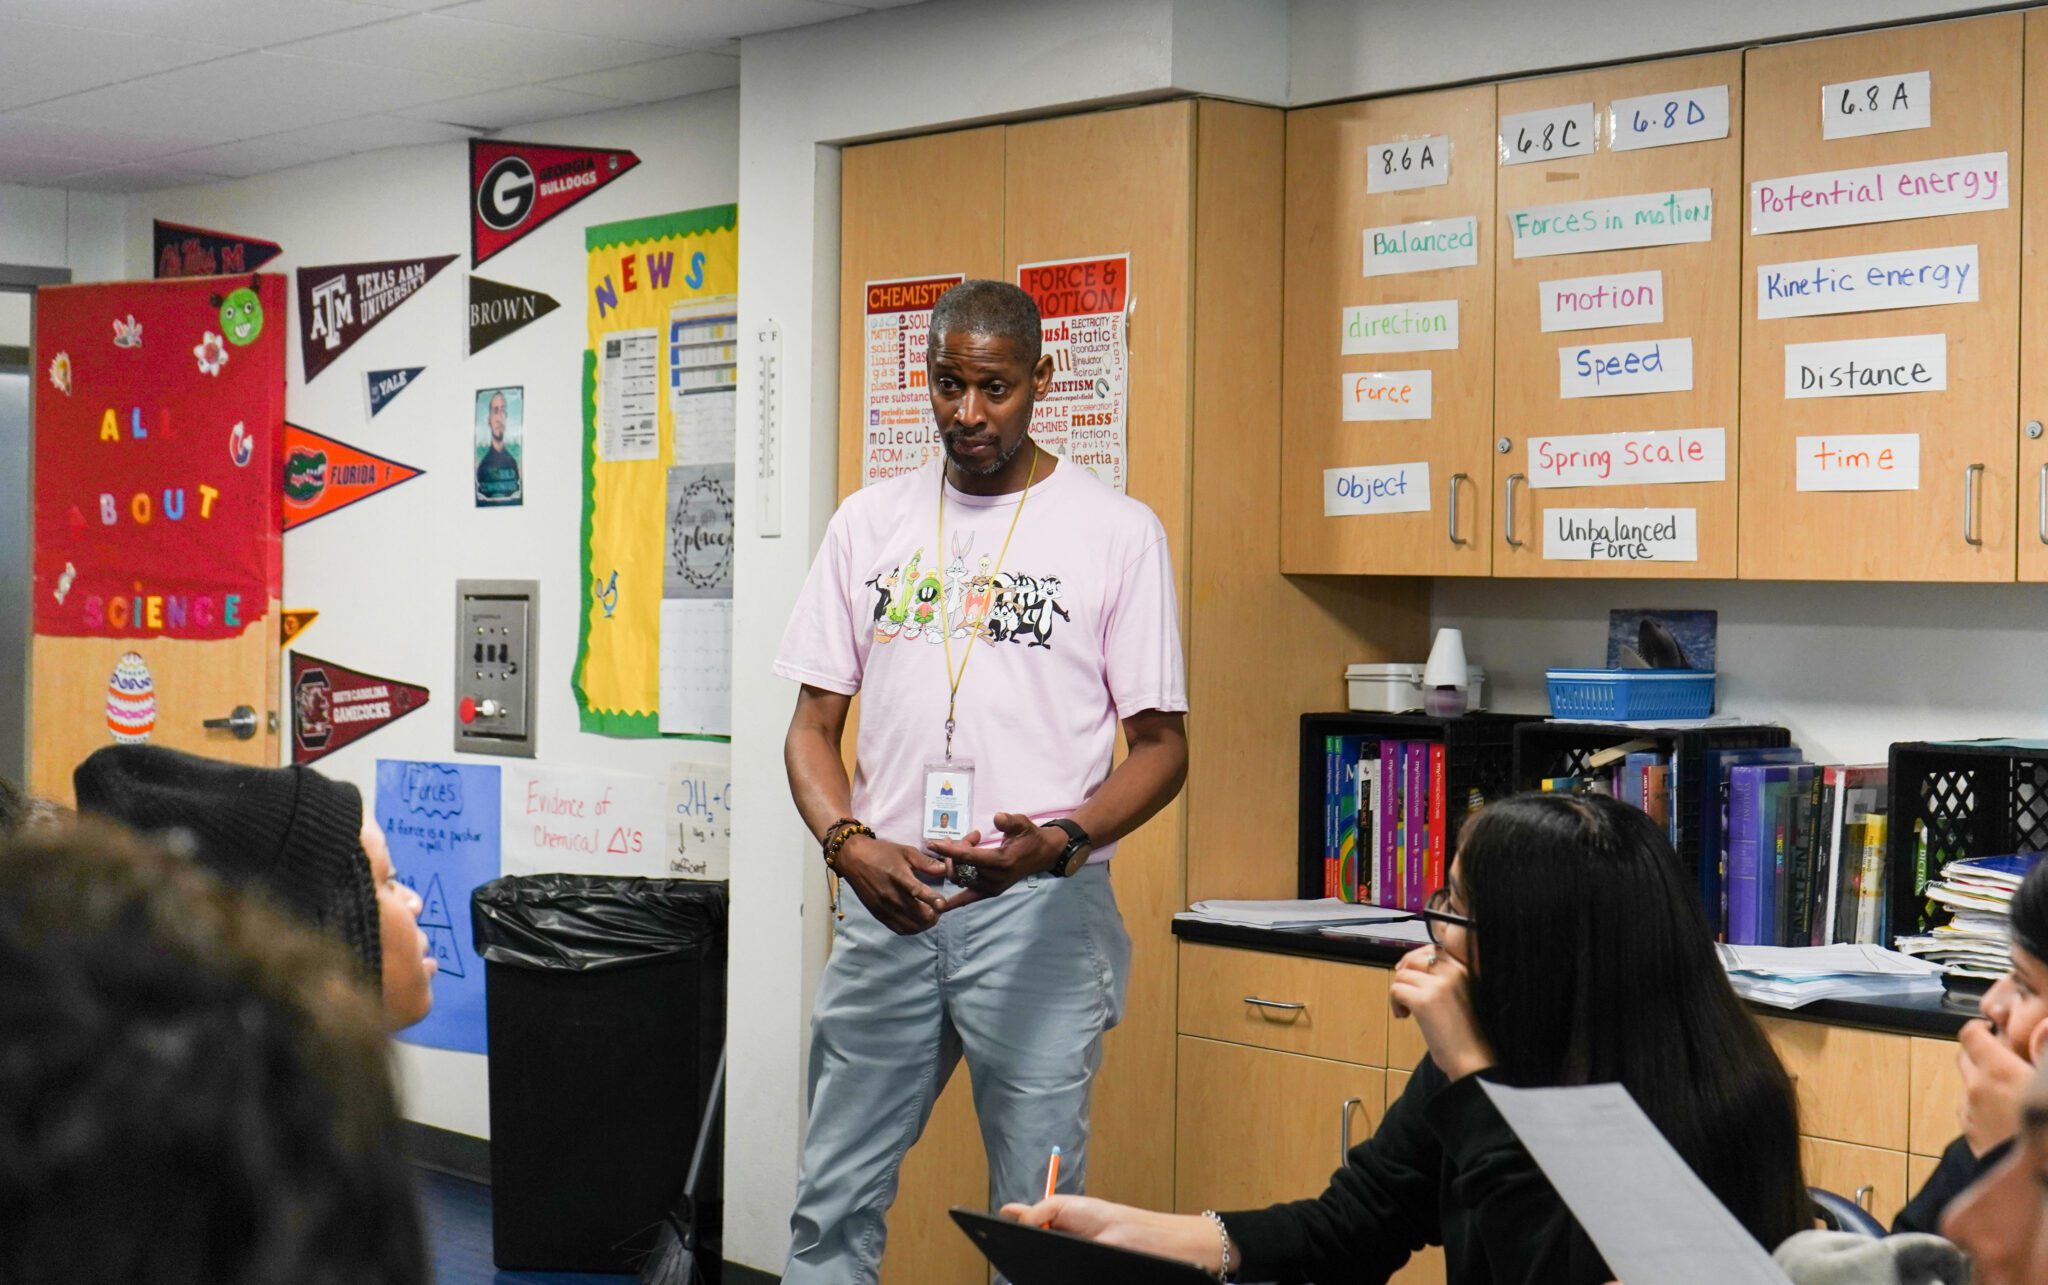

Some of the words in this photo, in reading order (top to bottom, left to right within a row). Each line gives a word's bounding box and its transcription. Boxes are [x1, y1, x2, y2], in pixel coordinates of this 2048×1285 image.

[539, 156, 596, 181] GEORGIA
[539, 171, 597, 197] BULLDOGS
[1760, 173, 1884, 214] Potential
[1898, 167, 1999, 200] energy
[1515, 208, 1598, 240] Forces
[1604, 212, 1624, 231] in
[1634, 193, 1711, 228] motion
[1373, 221, 1474, 257] Balanced
[357, 272, 396, 300] TEXAS
[397, 263, 426, 286] A&M
[594, 251, 706, 320] NEWS
[1029, 263, 1096, 292] FORCE
[1103, 262, 1117, 285] &
[1767, 266, 1855, 300] Kinetic
[1867, 262, 1971, 294] energy
[360, 277, 426, 325] UNIVERSITY
[868, 282, 960, 309] CHEMISTR
[1556, 284, 1655, 313] motion
[470, 295, 538, 327] BROWN
[1071, 317, 1110, 329] ELECTRICITY
[1070, 327, 1111, 344] static
[1349, 313, 1448, 339] direction
[871, 342, 898, 353] solid
[899, 314, 909, 390] element
[1076, 343, 1111, 354] conductor
[871, 355, 899, 367] liquid
[1577, 344, 1664, 385] Speed
[379, 371, 408, 397] YALE
[1048, 379, 1094, 393] GNETISM
[1800, 361, 1933, 391] Distance
[870, 394, 890, 406] pure
[1033, 406, 1069, 419] MPLE
[1071, 402, 1112, 412] acceleration
[1071, 412, 1112, 427] mass
[1071, 428, 1111, 440] friction
[1071, 440, 1111, 452] gravity
[869, 448, 903, 463] ATOM
[1071, 450, 1112, 465] inertia
[1539, 441, 1612, 479] Spring
[1624, 436, 1705, 464] Scale
[1814, 442, 1895, 472] time
[330, 465, 376, 486] FLORIDA
[684, 525, 726, 554] place
[1558, 516, 1677, 543] Unbalanced
[1590, 541, 1654, 560] Force
[351, 685, 389, 702] CAROLINA
[333, 702, 391, 723] GAMECOCKS
[408, 766, 456, 802] Forces
[526, 780, 585, 818] Evidence
[594, 787, 612, 817] of
[534, 825, 600, 856] Chemical
